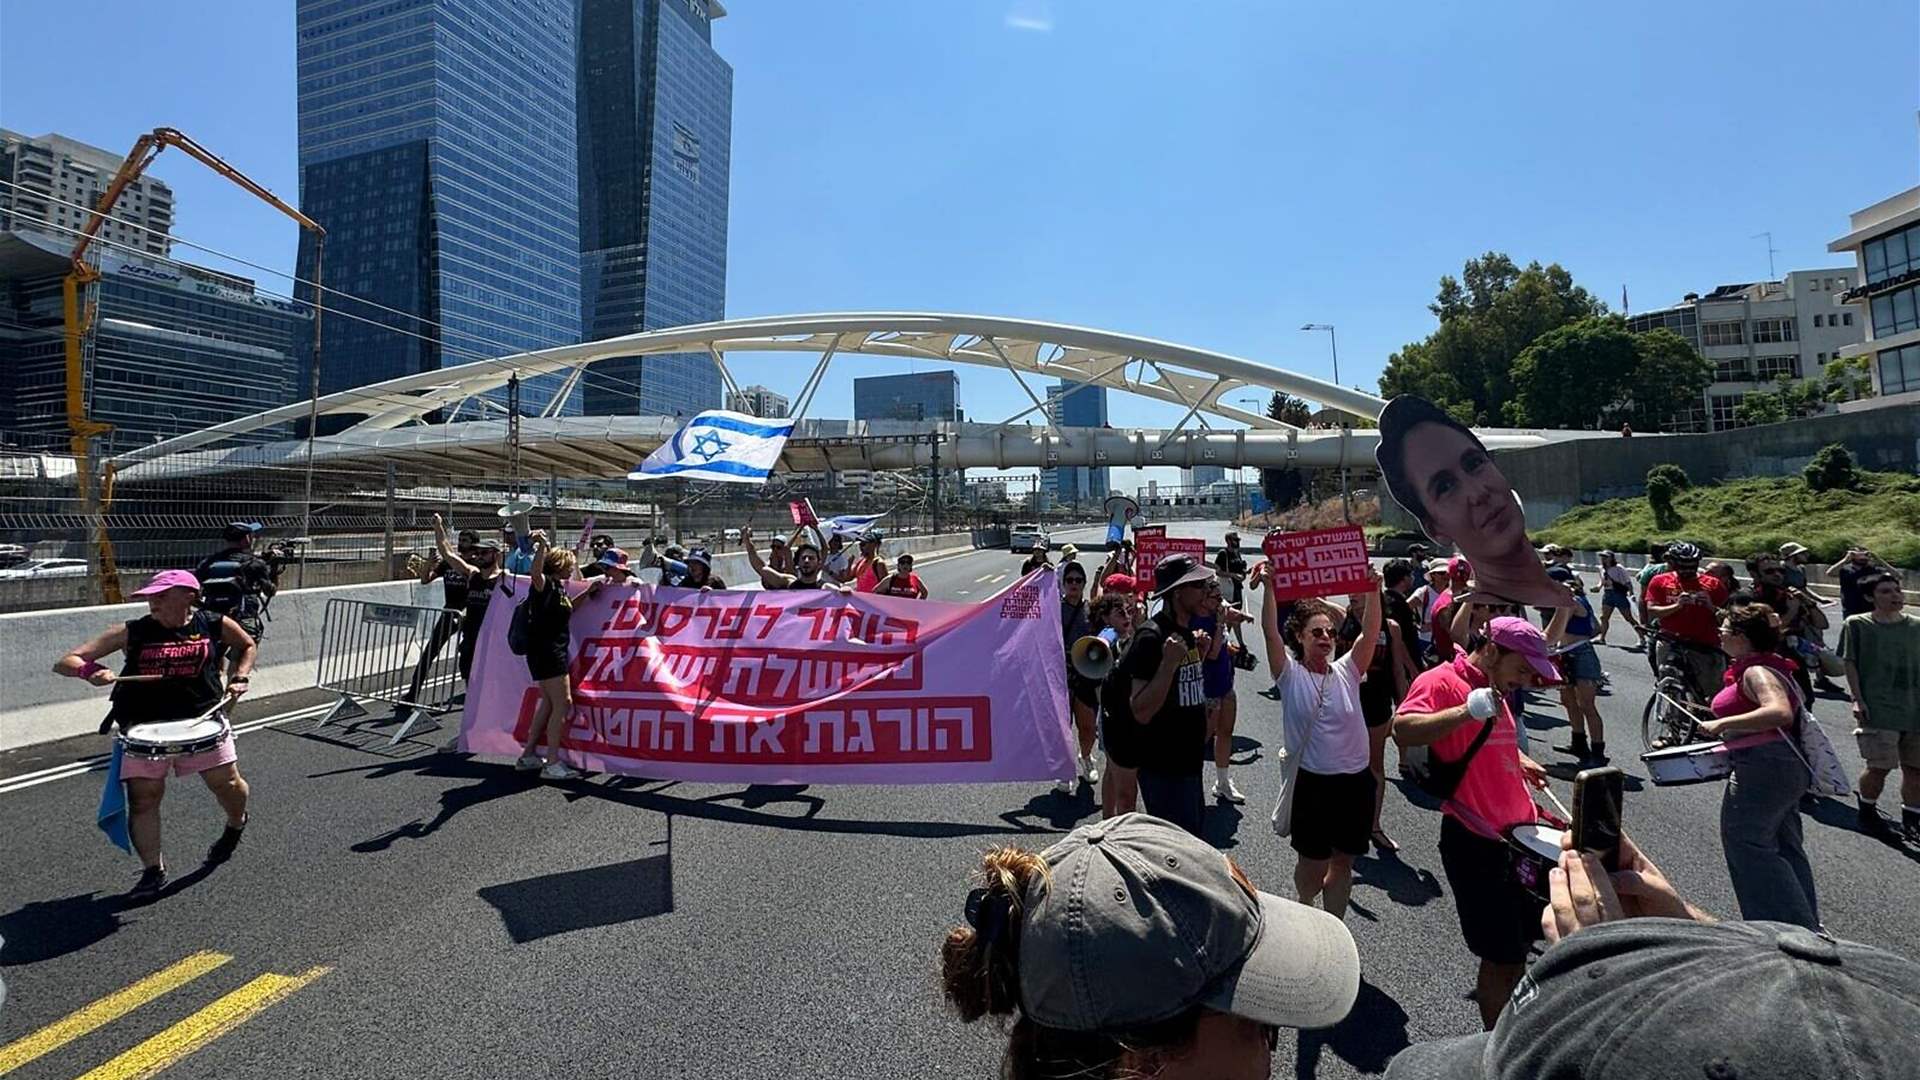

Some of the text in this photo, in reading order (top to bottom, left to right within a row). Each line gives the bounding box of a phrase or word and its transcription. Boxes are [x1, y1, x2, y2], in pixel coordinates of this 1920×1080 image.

[1269, 530, 1360, 550] ממשלת ישראל
[1272, 546, 1359, 569] הורגת את
[1275, 563, 1368, 589] החטופים
[798, 606, 919, 645] הותר
[581, 643, 717, 689] ישראל
[565, 703, 974, 753] הורגת את החטופי
